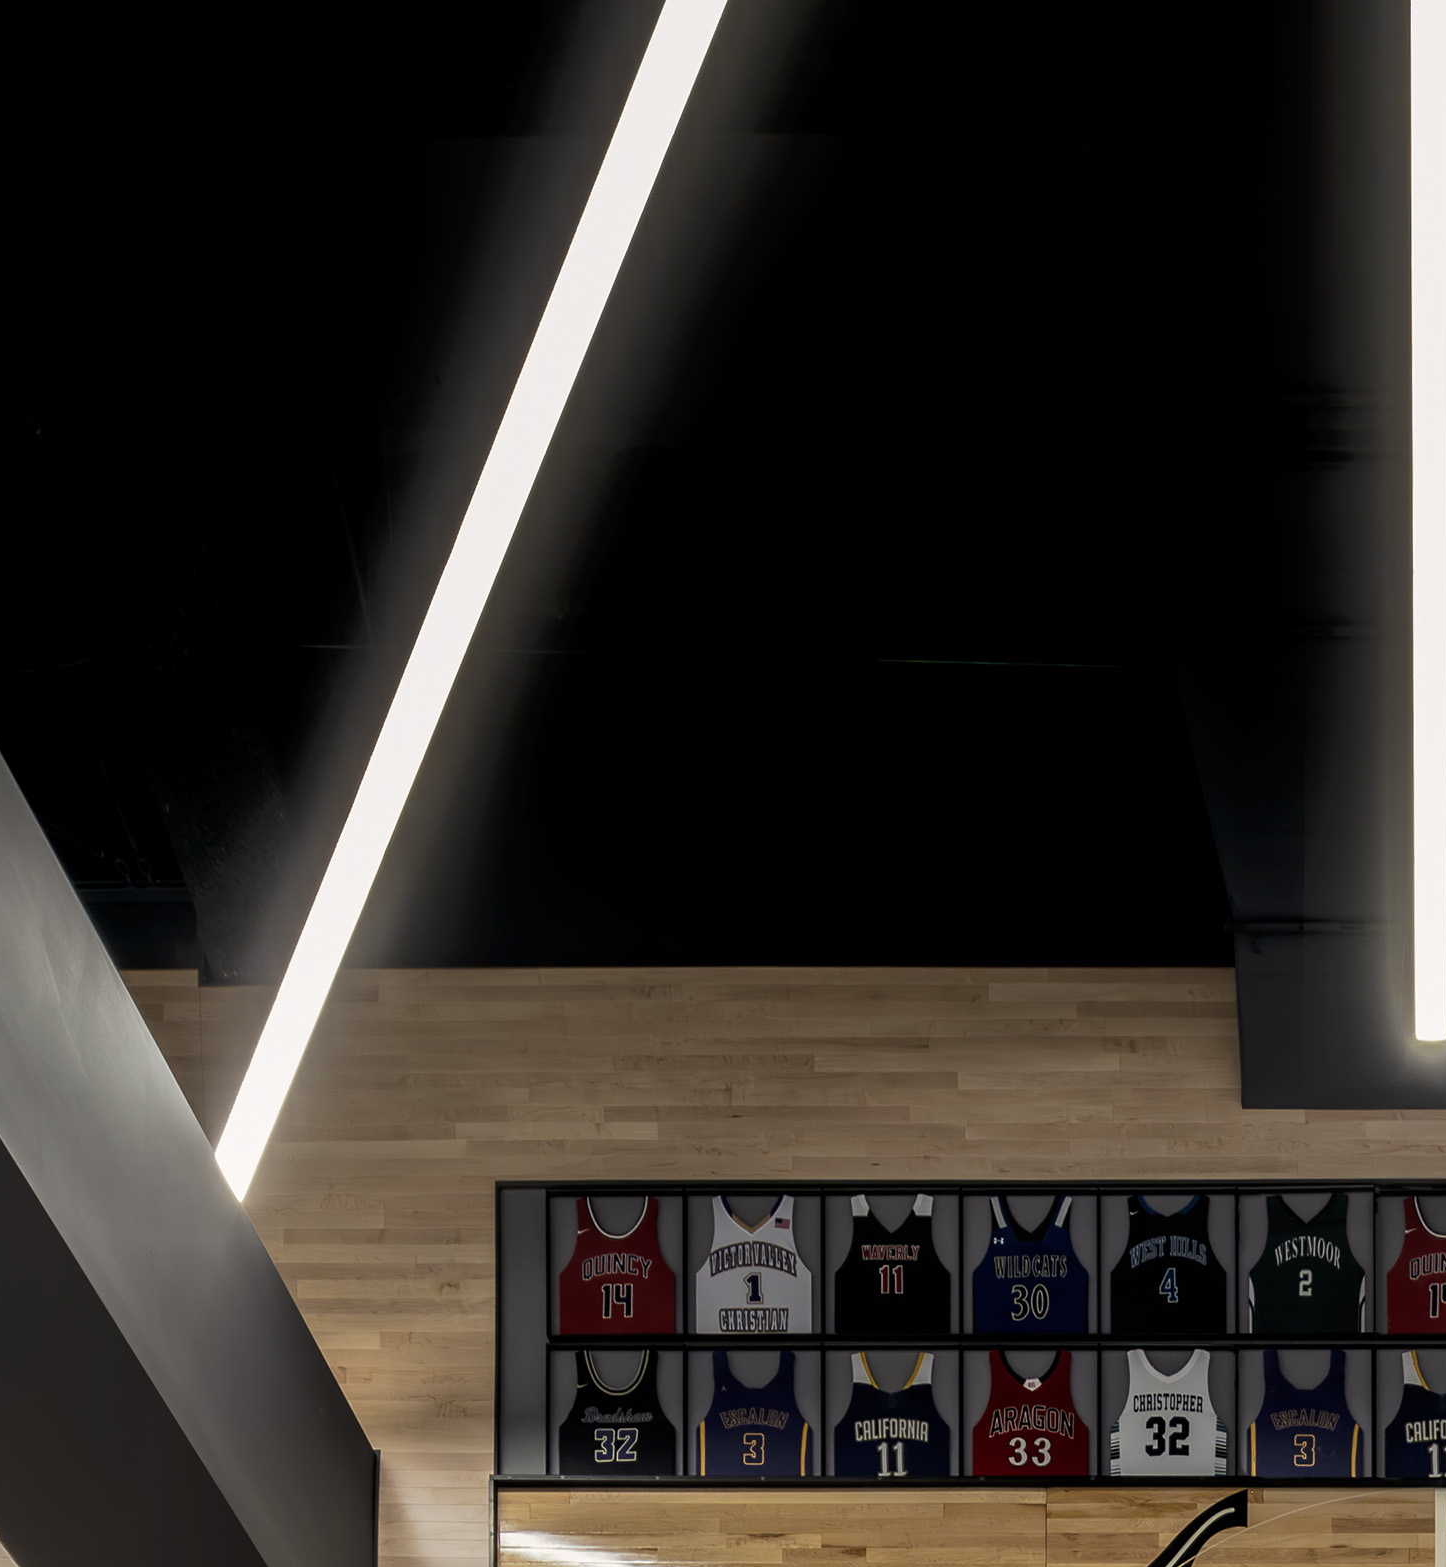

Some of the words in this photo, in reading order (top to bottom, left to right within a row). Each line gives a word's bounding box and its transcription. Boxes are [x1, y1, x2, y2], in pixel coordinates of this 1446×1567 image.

[581, 1252, 652, 1279] QUINCY
[709, 1241, 752, 1276] VICTOR
[754, 1241, 797, 1277] VALLEY
[861, 1244, 920, 1261] WAVERLY
[993, 1255, 1068, 1279] WILDCATS
[1129, 1236, 1167, 1268] WEST
[1170, 1235, 1208, 1267] HILLS
[1274, 1236, 1341, 1269] WESTMOOR
[601, 1283, 632, 1319] 14
[719, 1308, 788, 1333] CHRISTIAN
[1133, 1394, 1203, 1414] CHRISTOPHER
[855, 1420, 929, 1443] CALIFORNIA
[989, 1405, 1075, 1439] ARAGON
[1145, 1415, 1190, 1457] 32
[1008, 1436, 1052, 1467] 33
